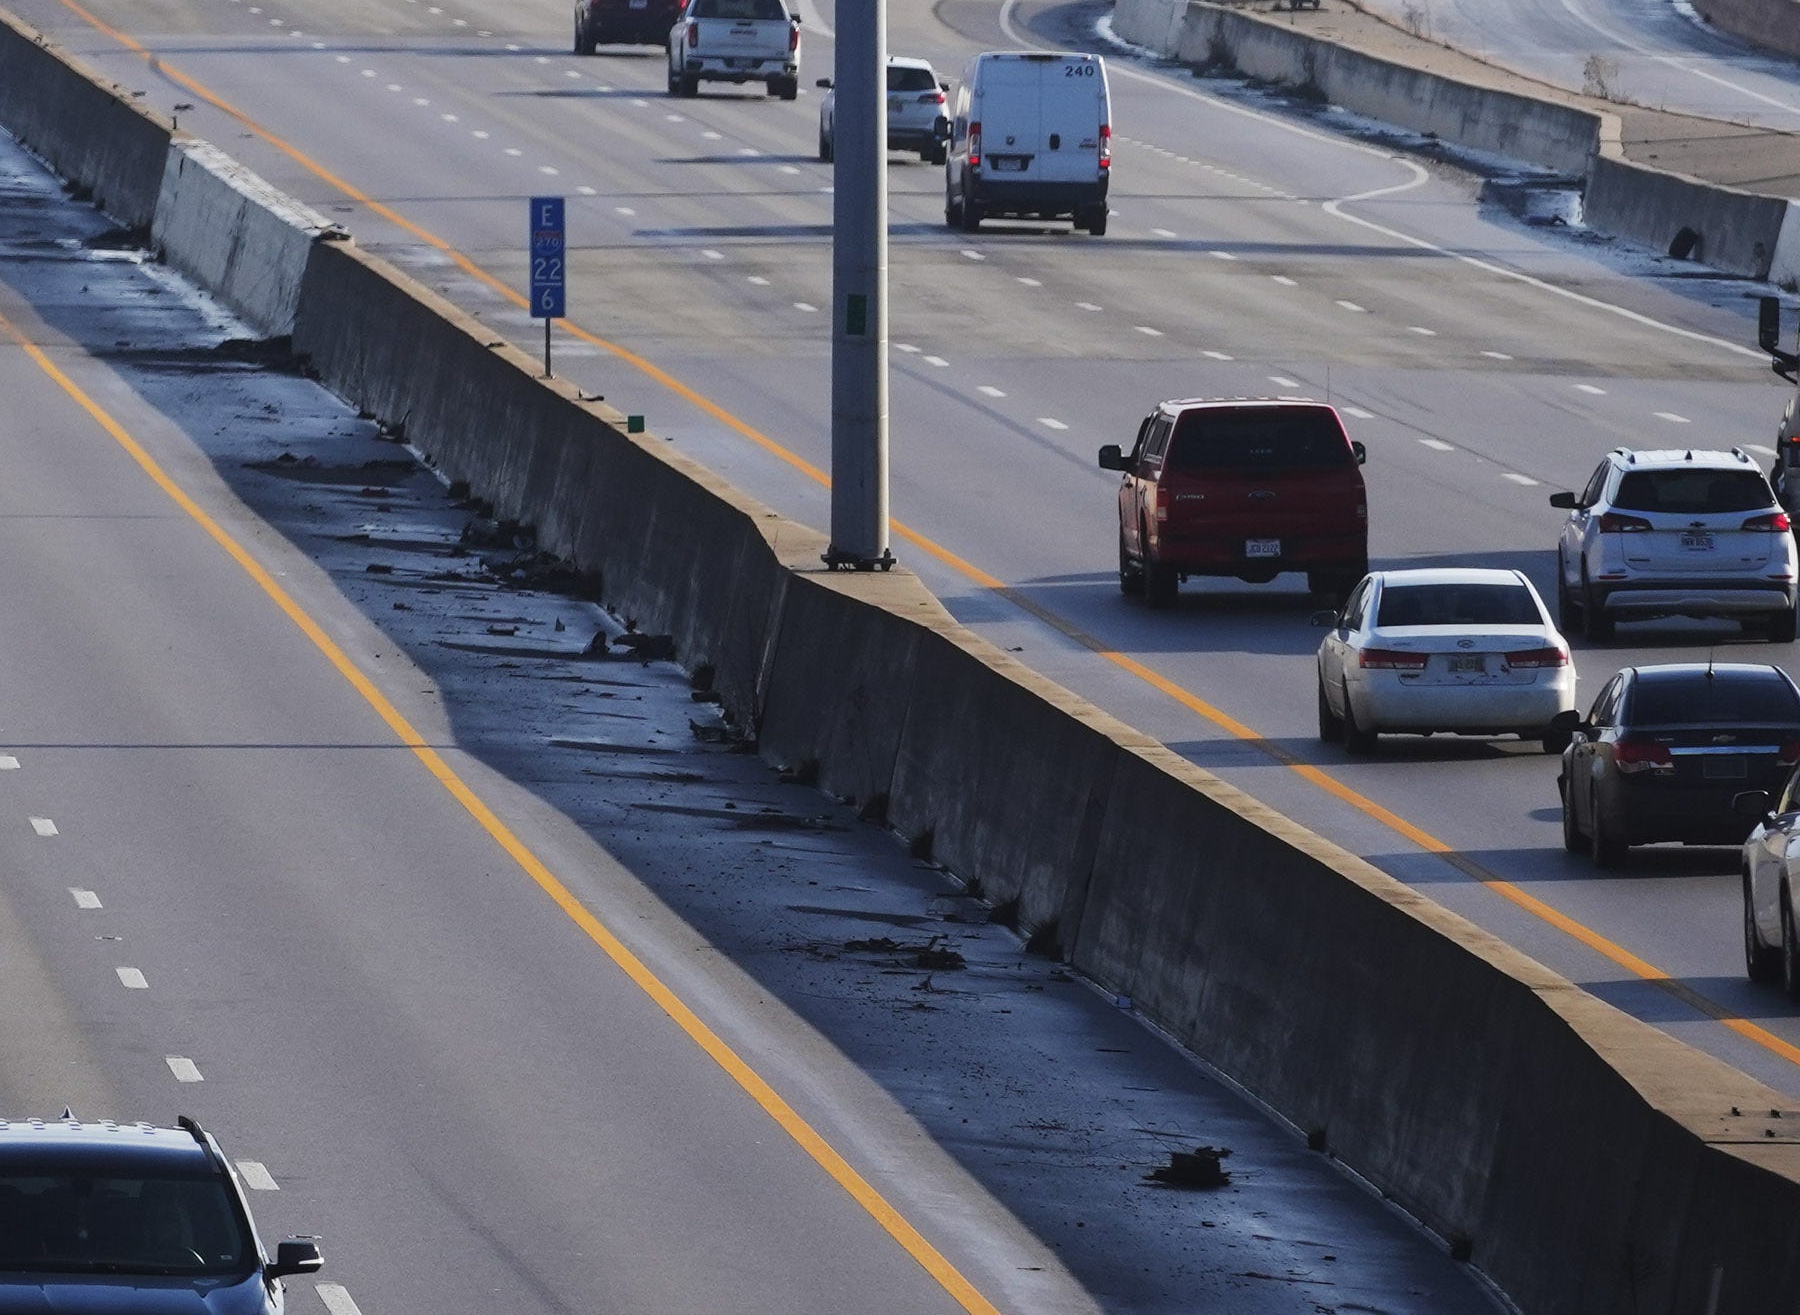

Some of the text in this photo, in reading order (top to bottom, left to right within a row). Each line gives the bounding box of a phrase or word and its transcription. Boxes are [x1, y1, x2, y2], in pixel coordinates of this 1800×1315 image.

[1065, 65, 1095, 78] 240
[541, 204, 554, 227] E
[536, 236, 560, 247] 270
[534, 258, 562, 280] 22
[541, 288, 554, 310] 6
